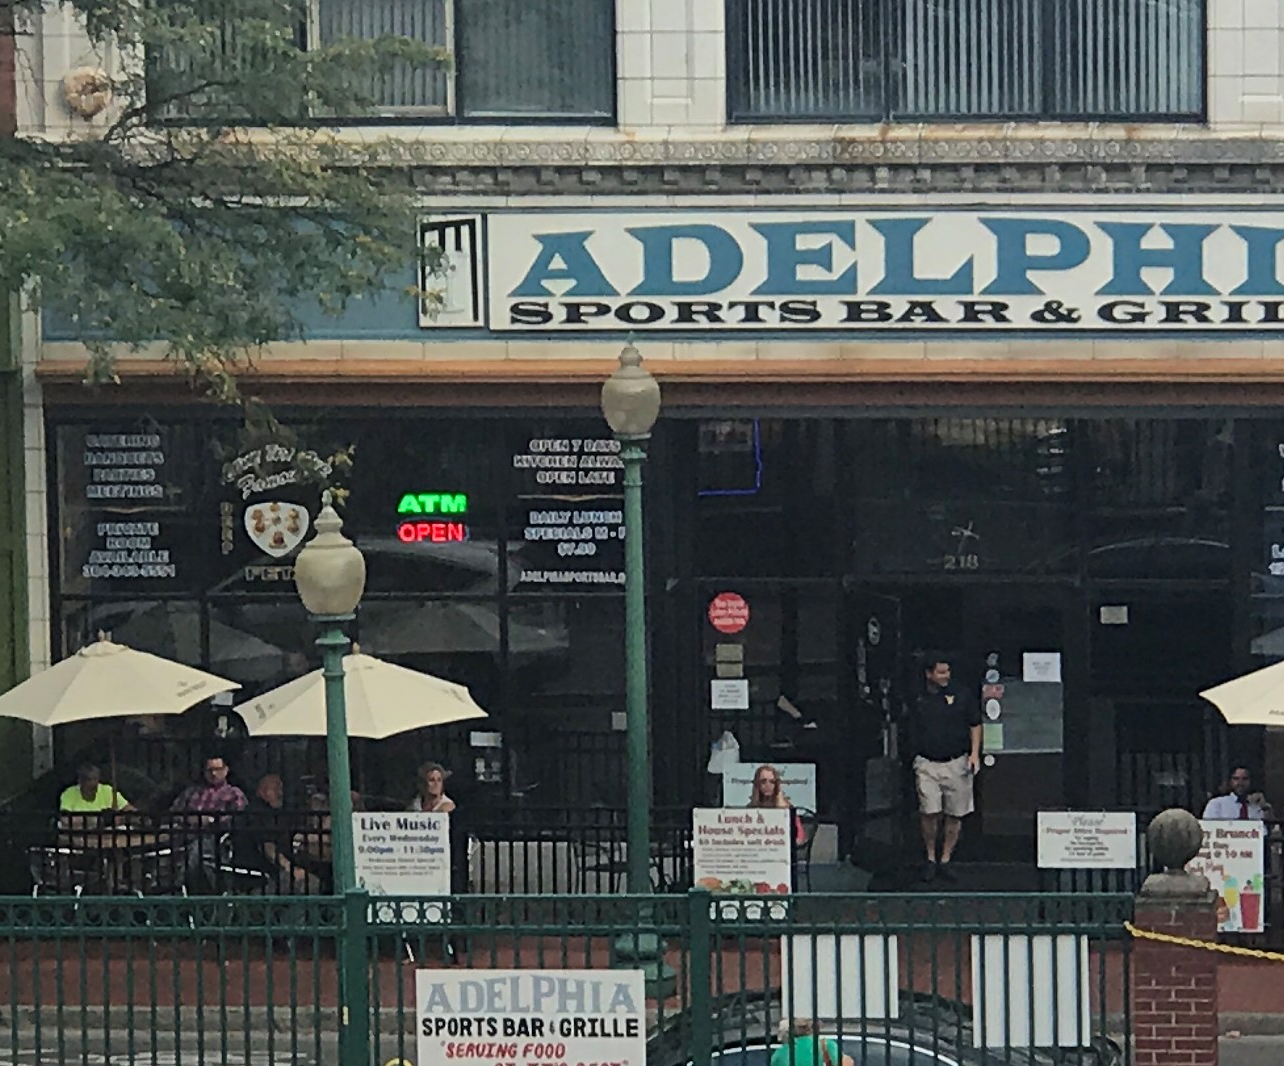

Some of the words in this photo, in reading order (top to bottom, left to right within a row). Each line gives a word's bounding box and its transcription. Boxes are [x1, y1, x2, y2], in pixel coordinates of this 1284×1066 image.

[509, 300, 823, 325] SPORTS
[839, 300, 1013, 325] BAR
[1030, 300, 1082, 325] &
[529, 439, 569, 452] OPEN
[571, 439, 582, 452] 7
[584, 439, 621, 452] DAYS
[513, 455, 577, 468] KITCHEN
[537, 471, 576, 484] OPEN
[579, 471, 616, 484] LATE
[398, 494, 467, 512] ATM
[529, 511, 571, 525] DAILY
[573, 511, 623, 524] LUNCH
[398, 522, 463, 542] OPEN
[524, 527, 592, 541] SPECIALS
[360, 817, 392, 831] Live
[396, 817, 442, 831] Music
[717, 813, 752, 825] Lunch
[737, 825, 786, 838] Specials
[1216, 828, 1260, 839] Brunch
[423, 974, 639, 1014] ADELPHIA
[421, 1017, 499, 1037] SPORTS
[502, 1018, 546, 1038] BAR
[559, 1017, 640, 1038] GRILLE
[522, 1041, 566, 1059] FOOD
